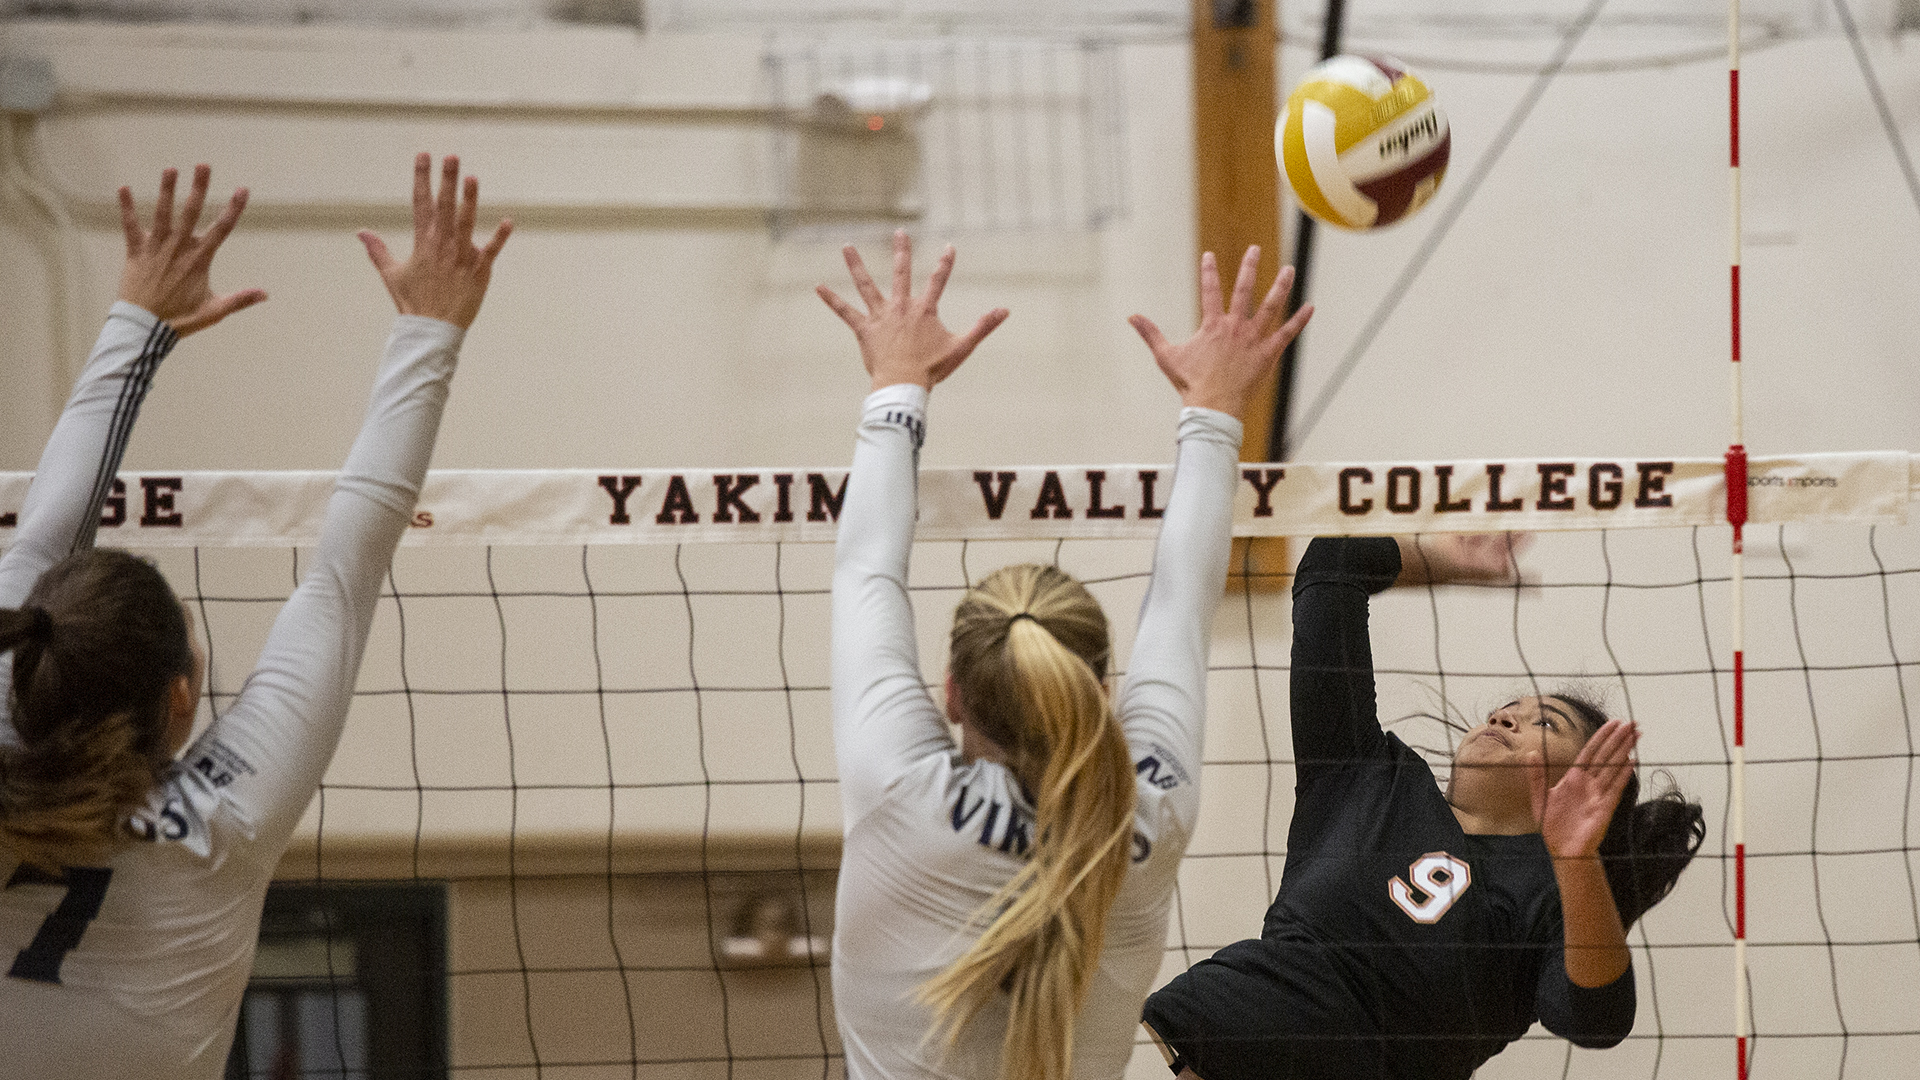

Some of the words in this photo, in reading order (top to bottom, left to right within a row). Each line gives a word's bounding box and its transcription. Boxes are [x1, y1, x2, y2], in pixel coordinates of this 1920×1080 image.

[598, 473, 850, 525] YAKIM
[973, 468, 1285, 520] VALLY
[1338, 461, 1675, 516] COLLEGE
[5, 861, 115, 985] 7
[1388, 850, 1472, 925] 9
